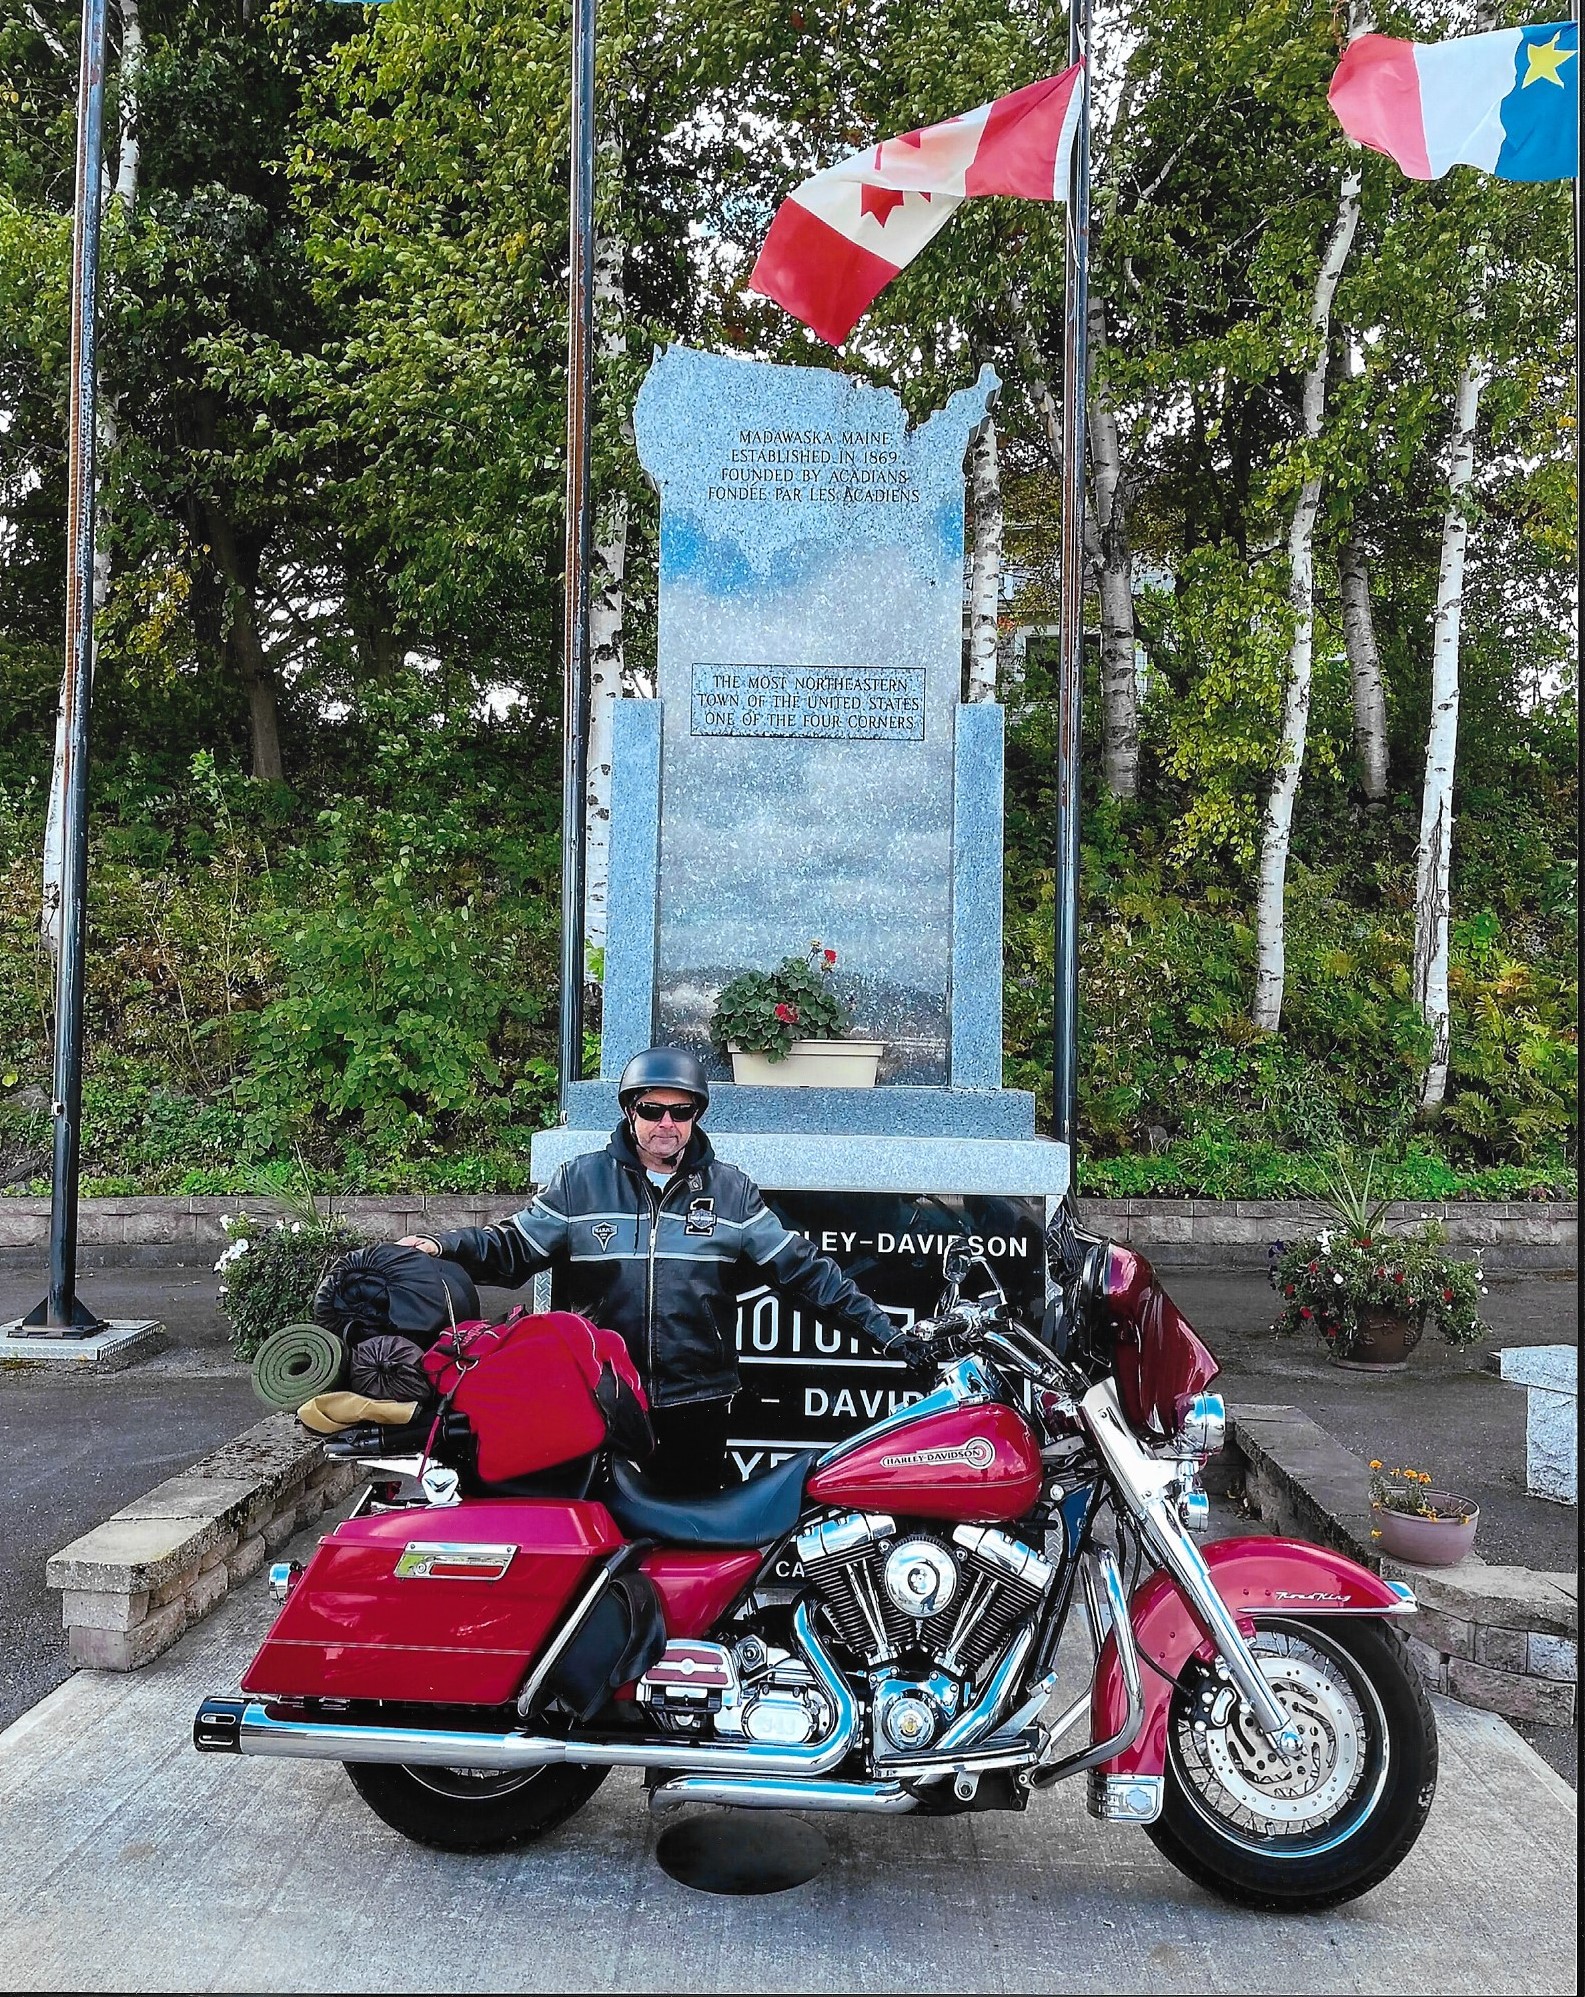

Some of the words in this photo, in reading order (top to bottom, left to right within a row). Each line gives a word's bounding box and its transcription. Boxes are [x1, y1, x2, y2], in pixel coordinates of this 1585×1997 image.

[739, 430, 833, 445] MADAWASKA
[842, 431, 891, 445] MAINE
[731, 449, 831, 464] ESTABLISHED
[840, 449, 855, 464] IN
[863, 450, 898, 465] 1869
[721, 467, 794, 482] FOUNDED
[802, 469, 821, 483] BY
[830, 469, 909, 484] ACADIANS
[708, 481, 767, 501] FONDÉE
[775, 487, 802, 502] PAR
[810, 487, 836, 502] LES
[844, 487, 920, 503] ACADIENS
[712, 674, 741, 689] THE
[749, 675, 787, 689] MOST
[795, 676, 908, 692] NORTHEASTERN
[697, 693, 740, 708] TOWN
[747, 693, 766, 708] OF
[773, 694, 801, 709] THE
[807, 695, 861, 710] UNITED
[868, 696, 920, 711] STATES
[705, 711, 735, 726] ONE
[742, 711, 761, 726] OF
[768, 713, 796, 727] THE
[803, 714, 842, 728] FOUR
[848, 714, 915, 730] CORNERS
[886, 1449, 981, 1466] HARLEY-DAVIDSON
